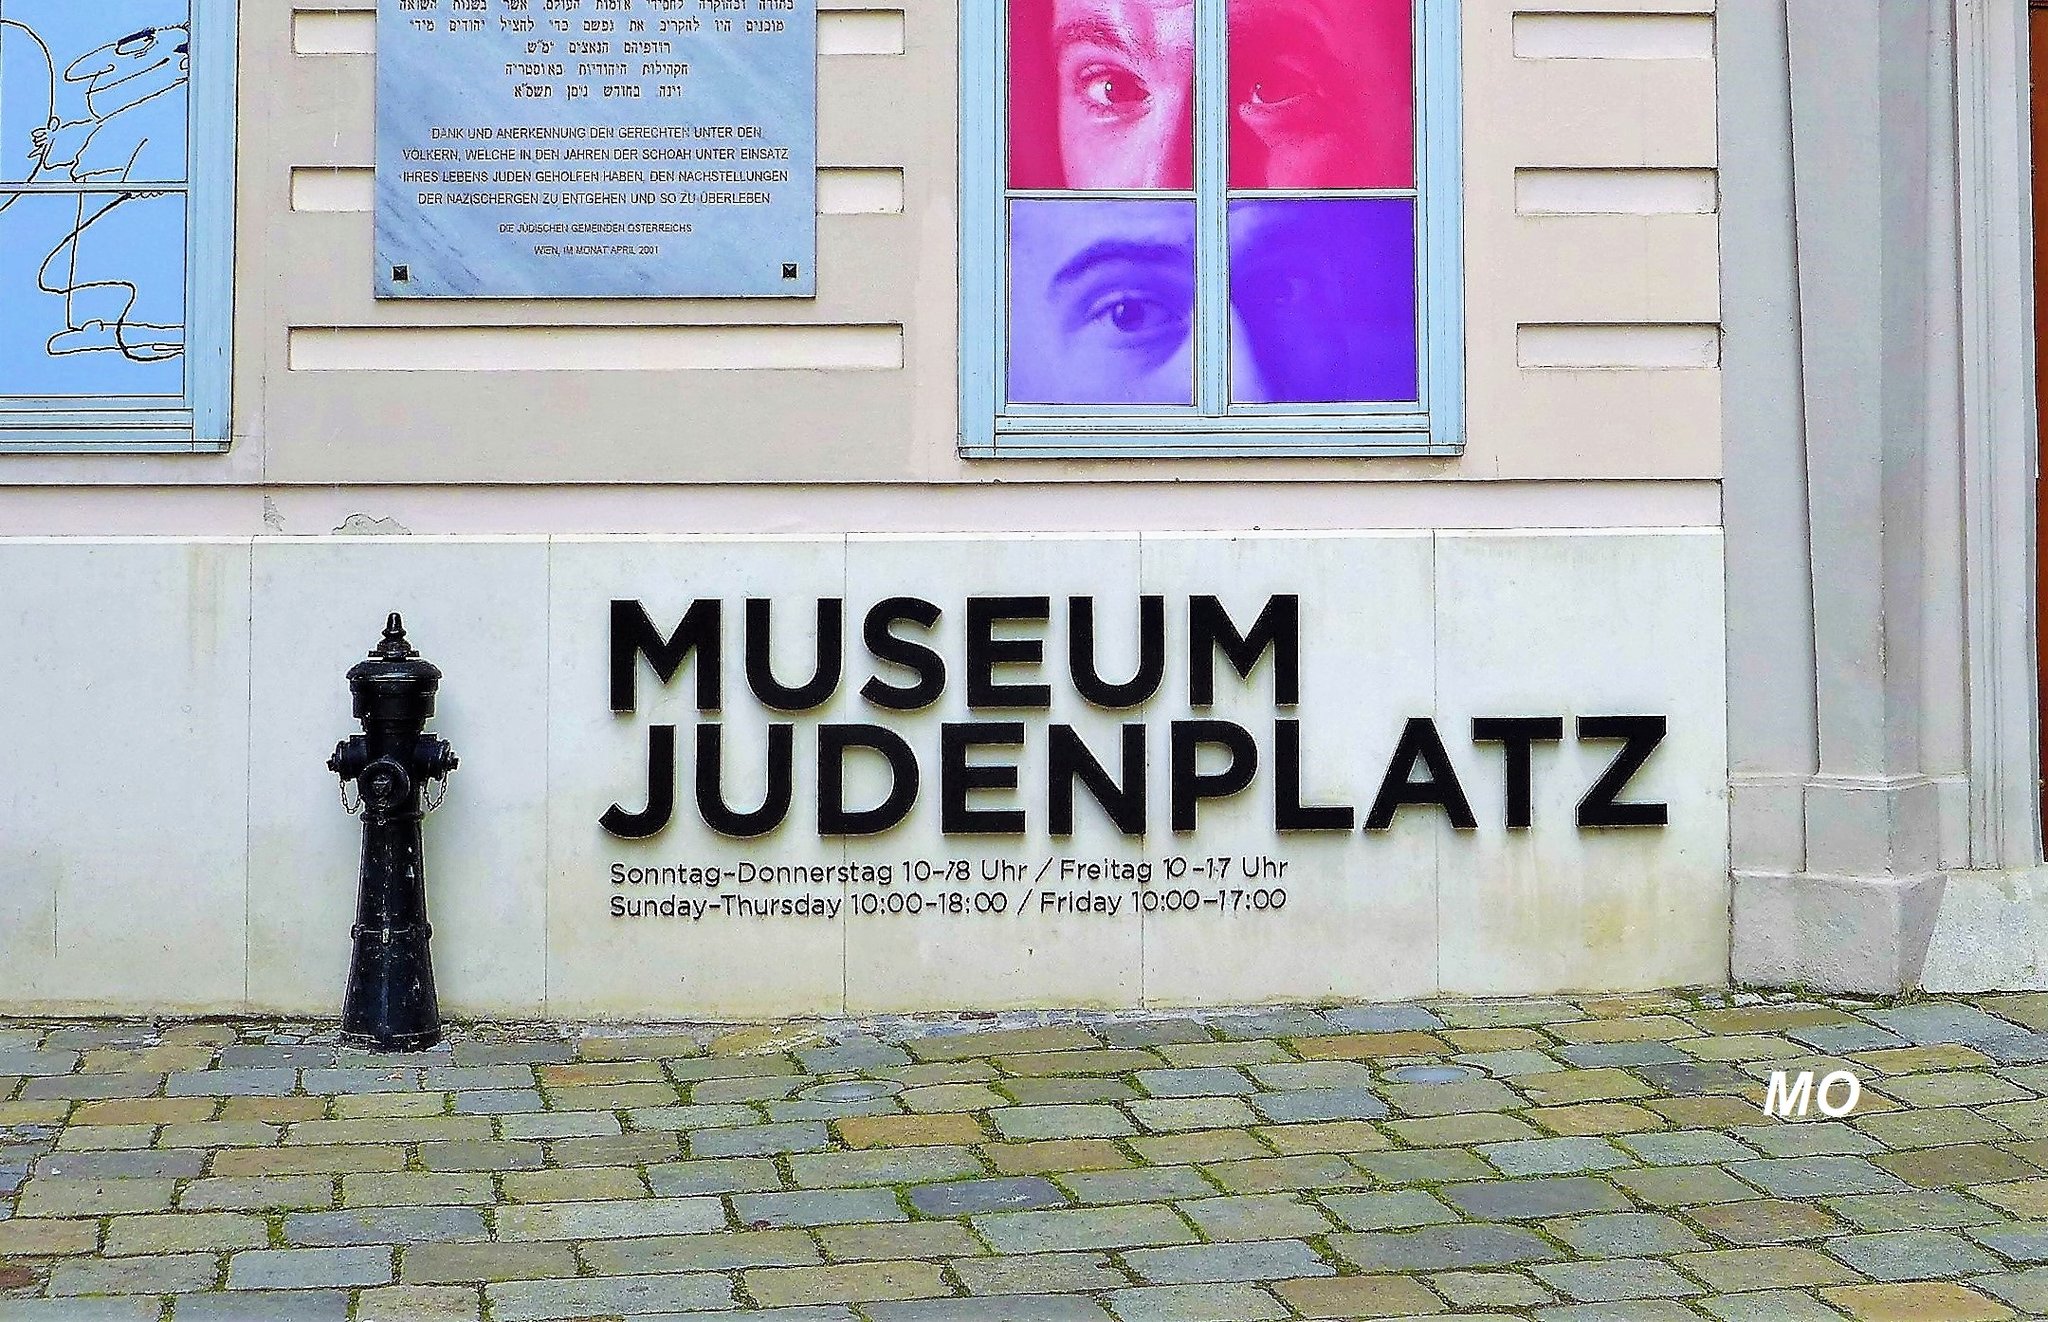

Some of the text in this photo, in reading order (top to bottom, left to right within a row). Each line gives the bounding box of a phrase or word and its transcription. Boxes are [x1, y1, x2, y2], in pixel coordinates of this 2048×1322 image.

[629, 19, 645, 32] את
[431, 126, 763, 140] DANK UND ANERKENNUNG DEN GERECHTEN UNTER DEN
[464, 148, 516, 161] WELCHE
[519, 148, 533, 161] IN
[535, 148, 560, 161] DEN
[563, 148, 610, 161] JAHREN
[613, 148, 639, 161] DER
[642, 148, 692, 161] SCHOAH
[695, 148, 736, 161] UNTER
[740, 148, 789, 161] EINSATZ
[403, 170, 439, 182] IHRES
[442, 170, 489, 182] LEBENS
[492, 170, 532, 182] JUDEN
[535, 170, 599, 182] GEHOLFEN
[650, 169, 675, 182] DEN
[678, 169, 789, 182] NACHSTELLUNGEN
[418, 192, 443, 204] DER
[446, 192, 539, 204] NAZISCHERGEN
[542, 192, 559, 204] ZU
[562, 192, 627, 204] ENTGEHEN
[630, 192, 656, 204] UND
[660, 192, 677, 204] SO
[679, 192, 696, 204] ZU
[499, 223, 515, 234] DIE
[571, 223, 626, 234] GEMEINDEN
[575, 245, 609, 255] MONAT
[610, 245, 635, 255] APRIL
[609, 594, 1300, 713] MUSEUM
[598, 714, 1669, 838] JUDENPLATZ
[981, 859, 1028, 882] Uhr
[1060, 858, 1152, 883] Freitag
[1241, 855, 1289, 879] Uhr
[1040, 889, 1123, 916] Friday
